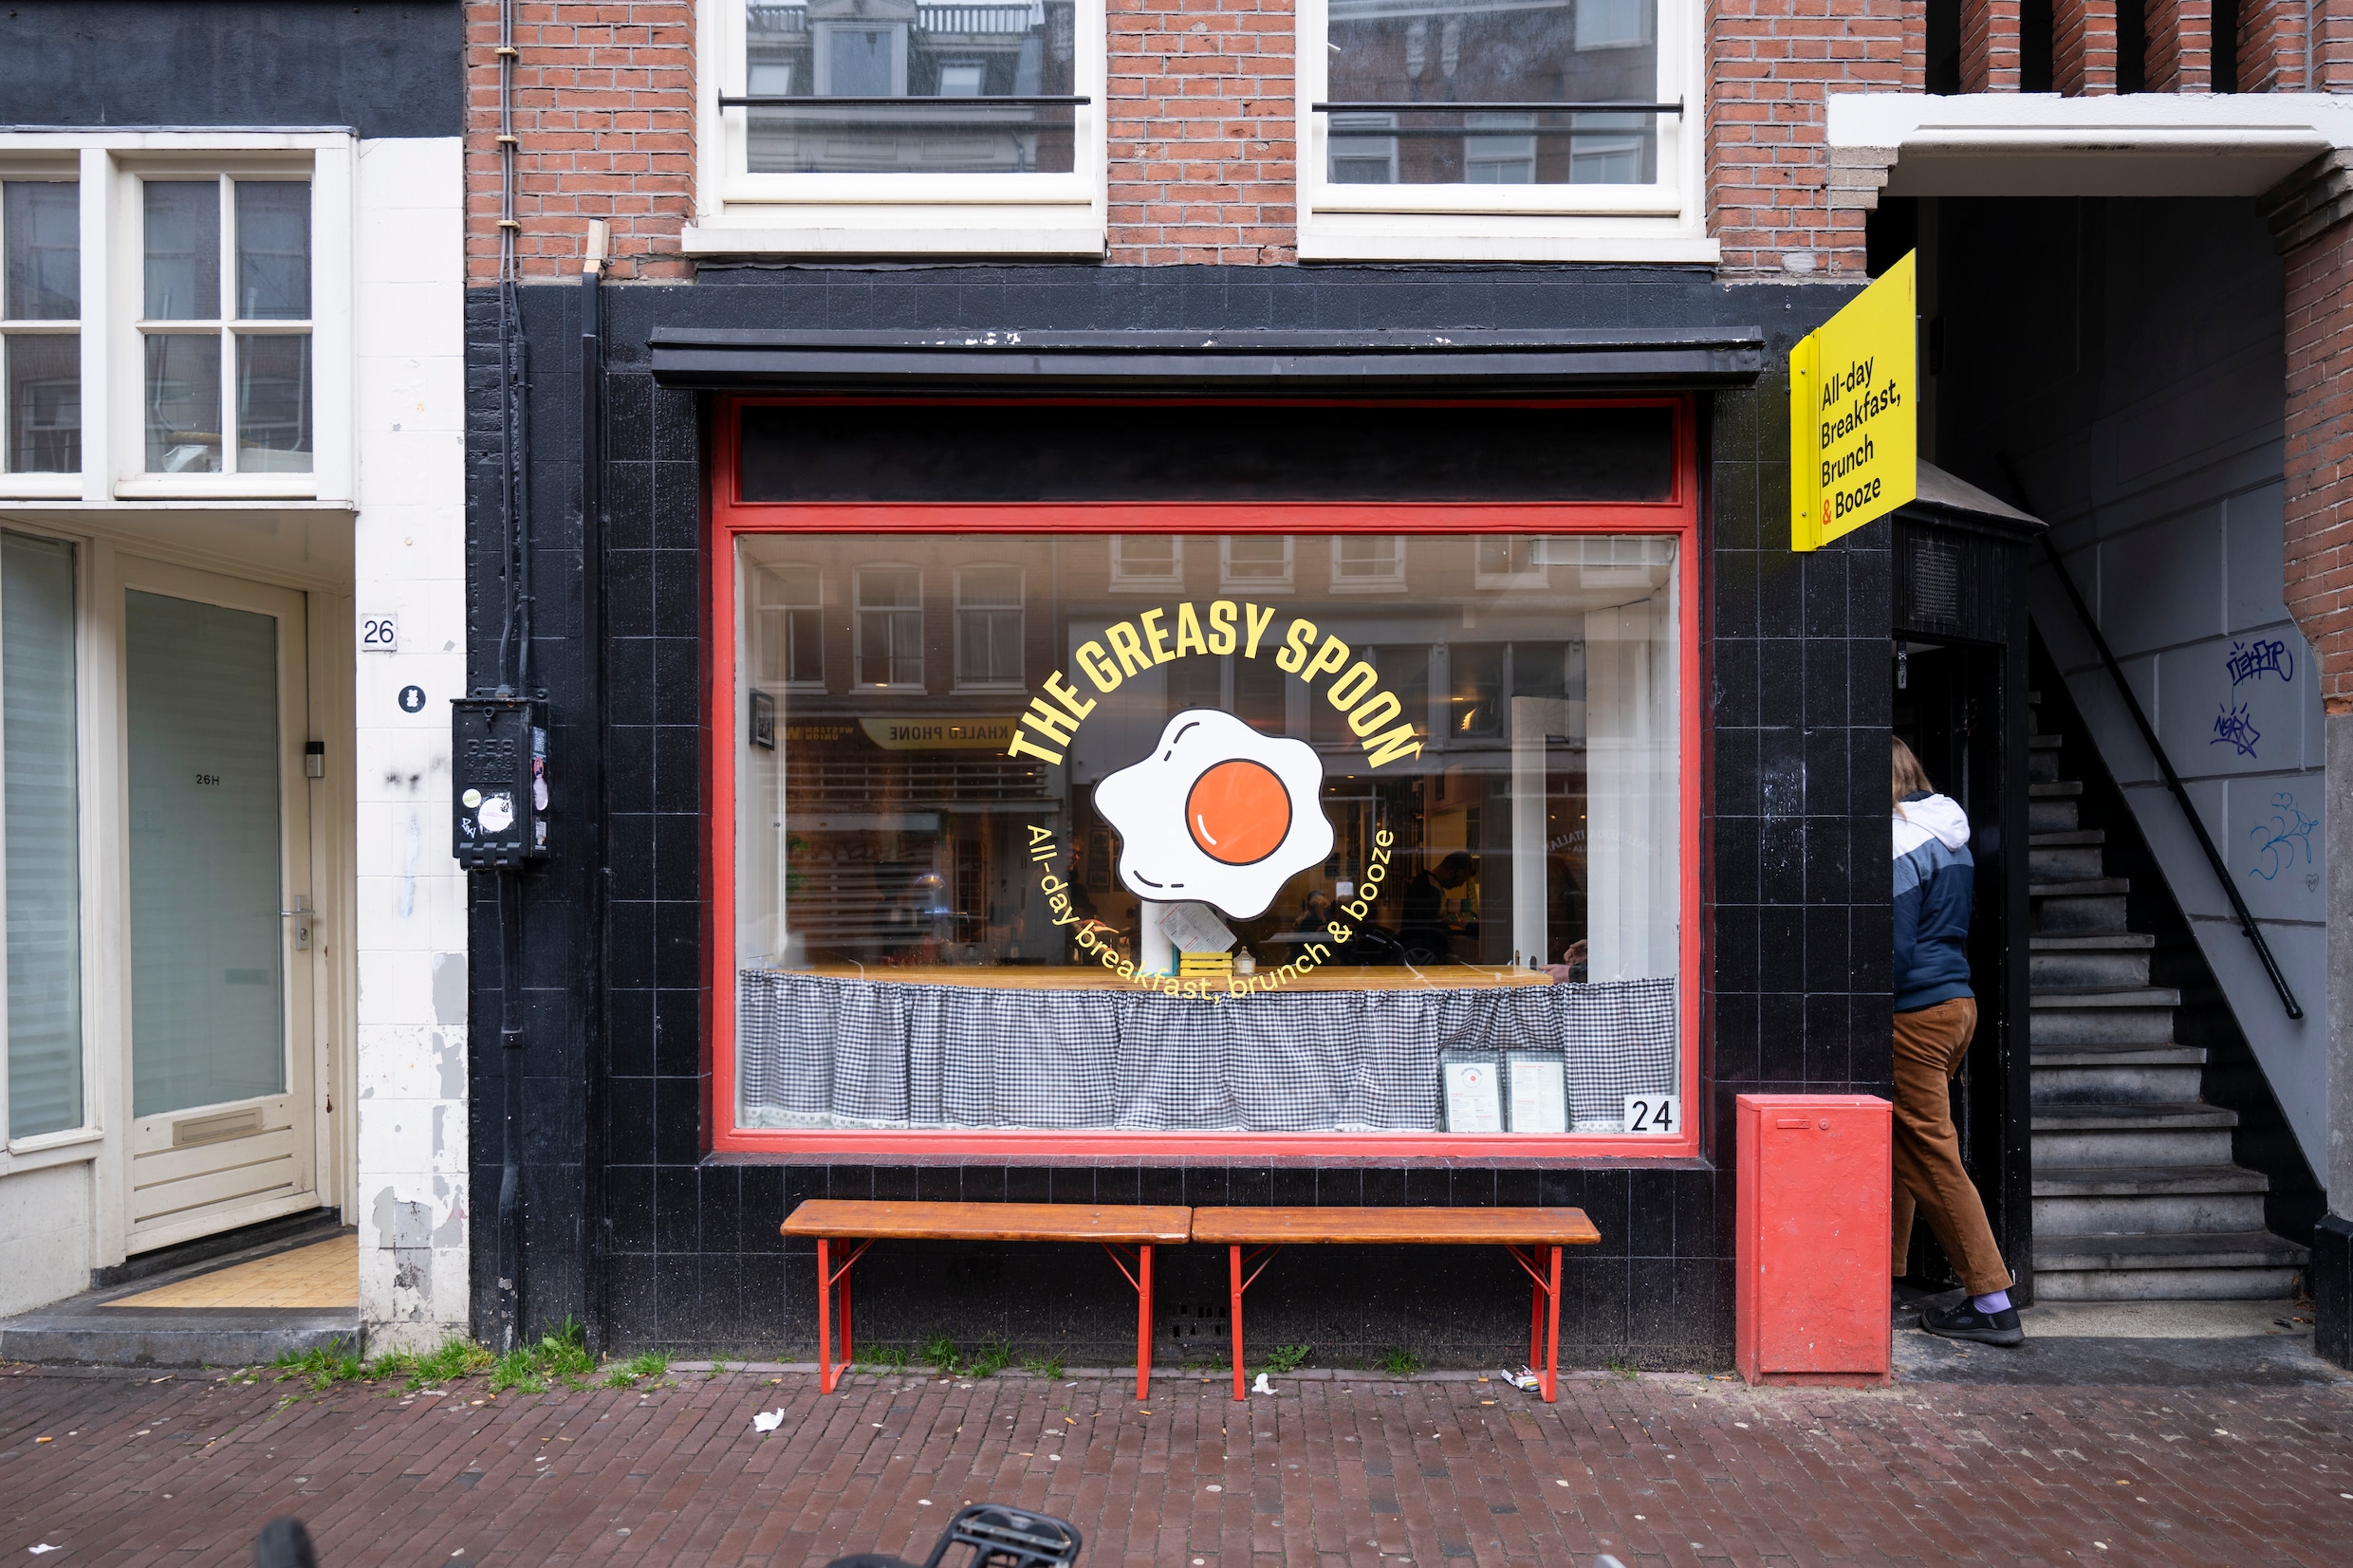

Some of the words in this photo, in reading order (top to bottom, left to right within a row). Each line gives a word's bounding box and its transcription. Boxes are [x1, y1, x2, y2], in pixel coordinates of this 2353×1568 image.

[1822, 356, 1874, 412] All-day
[1822, 378, 1901, 451] Breakfast,
[1822, 433, 1874, 489] Brunch
[1822, 498, 1832, 526] &
[1835, 477, 1881, 520] Booze
[364, 619, 395, 644] 26
[1007, 670, 1097, 766] THE
[1075, 600, 1276, 693] GREASY
[1275, 618, 1421, 769] SPOON
[195, 774, 220, 785] 26H
[1027, 824, 1081, 927] All-day
[1075, 920, 1221, 1005] breakfast,
[1226, 943, 1331, 1001] brunch
[1327, 921, 1353, 945] &
[1340, 828, 1395, 922] booze
[1630, 1099, 1674, 1132] 24
